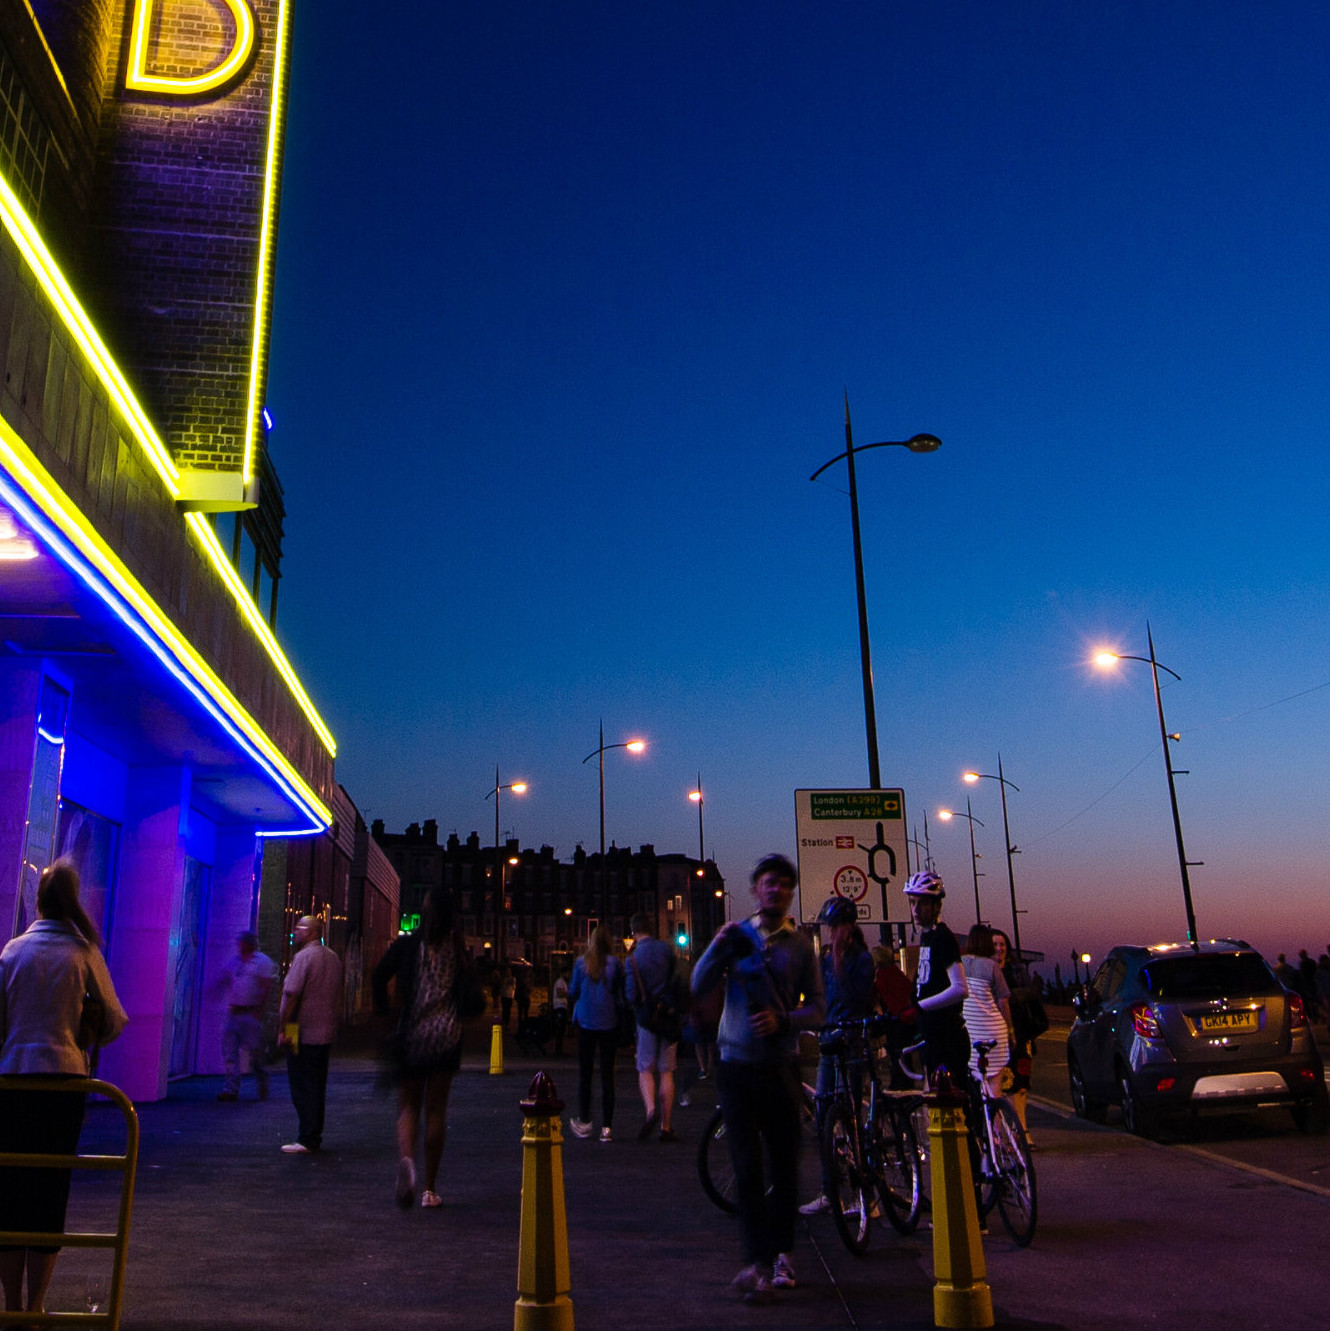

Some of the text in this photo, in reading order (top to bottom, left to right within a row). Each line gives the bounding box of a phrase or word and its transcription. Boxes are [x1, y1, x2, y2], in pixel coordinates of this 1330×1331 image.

[814, 795, 880, 805] London (A299)
[814, 807, 883, 818] Canterbury A28
[801, 838, 834, 847] Station
[1204, 1013, 1251, 1028] GK14 APY
